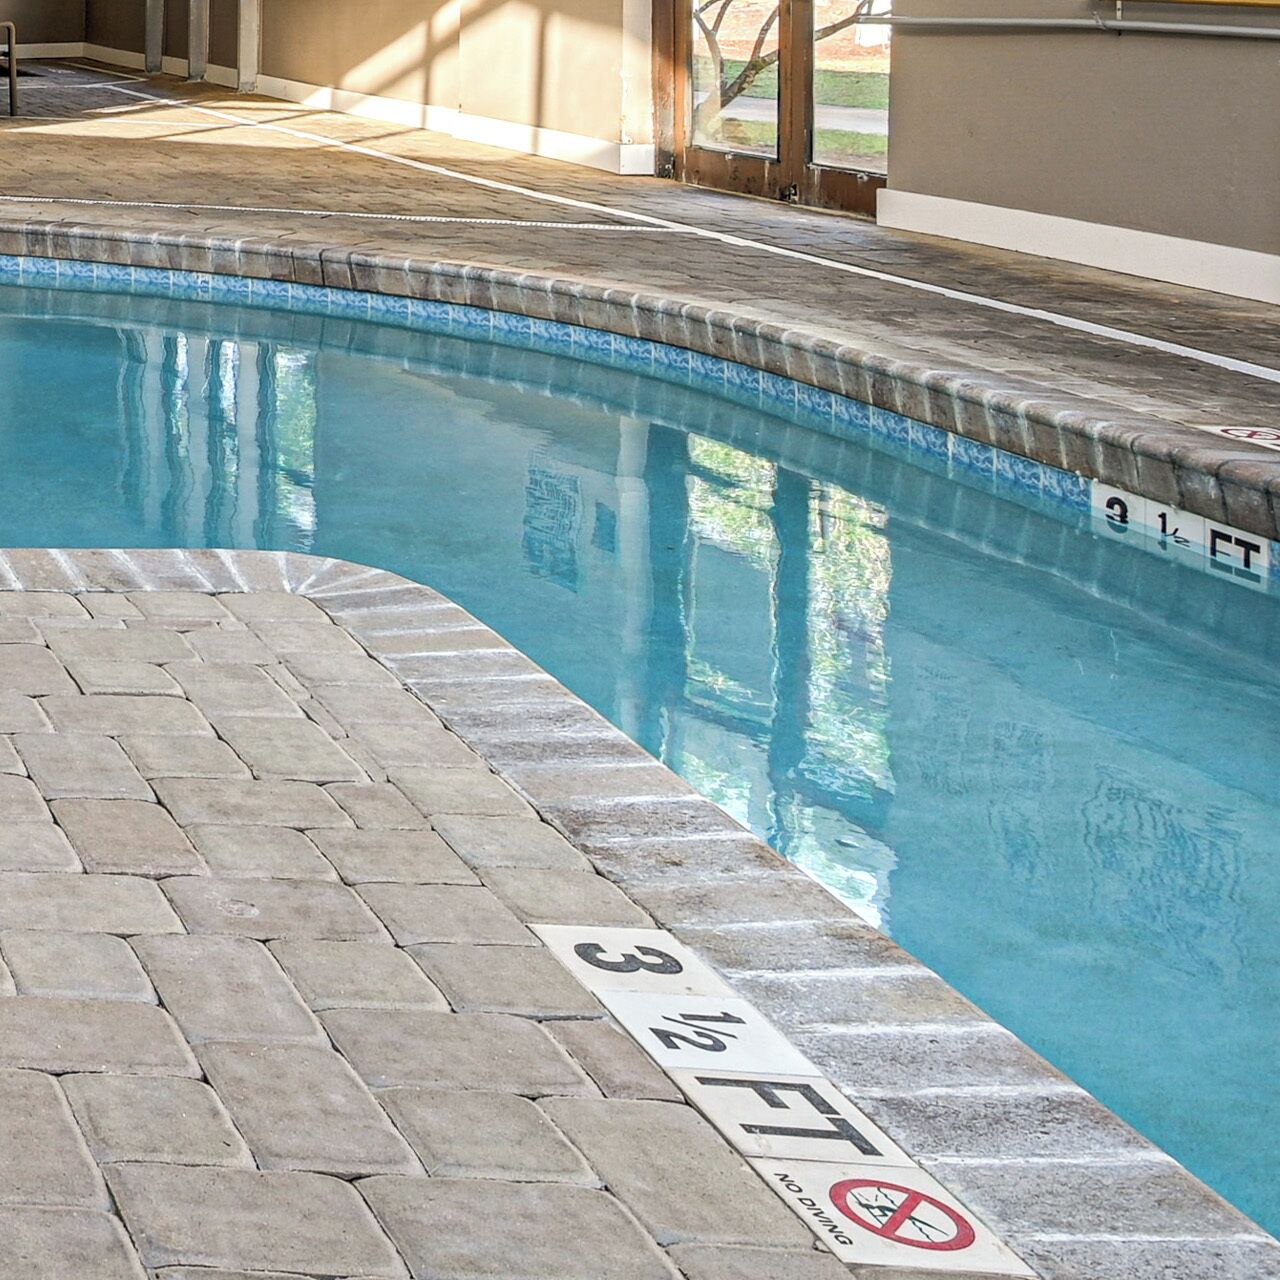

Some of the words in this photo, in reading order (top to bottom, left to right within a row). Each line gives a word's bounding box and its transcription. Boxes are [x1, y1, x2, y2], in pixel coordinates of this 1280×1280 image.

[573, 942, 684, 975] 3
[694, 1076, 884, 1156] FT
[773, 1172, 802, 1194] NO
[798, 1192, 853, 1246] DIVING
